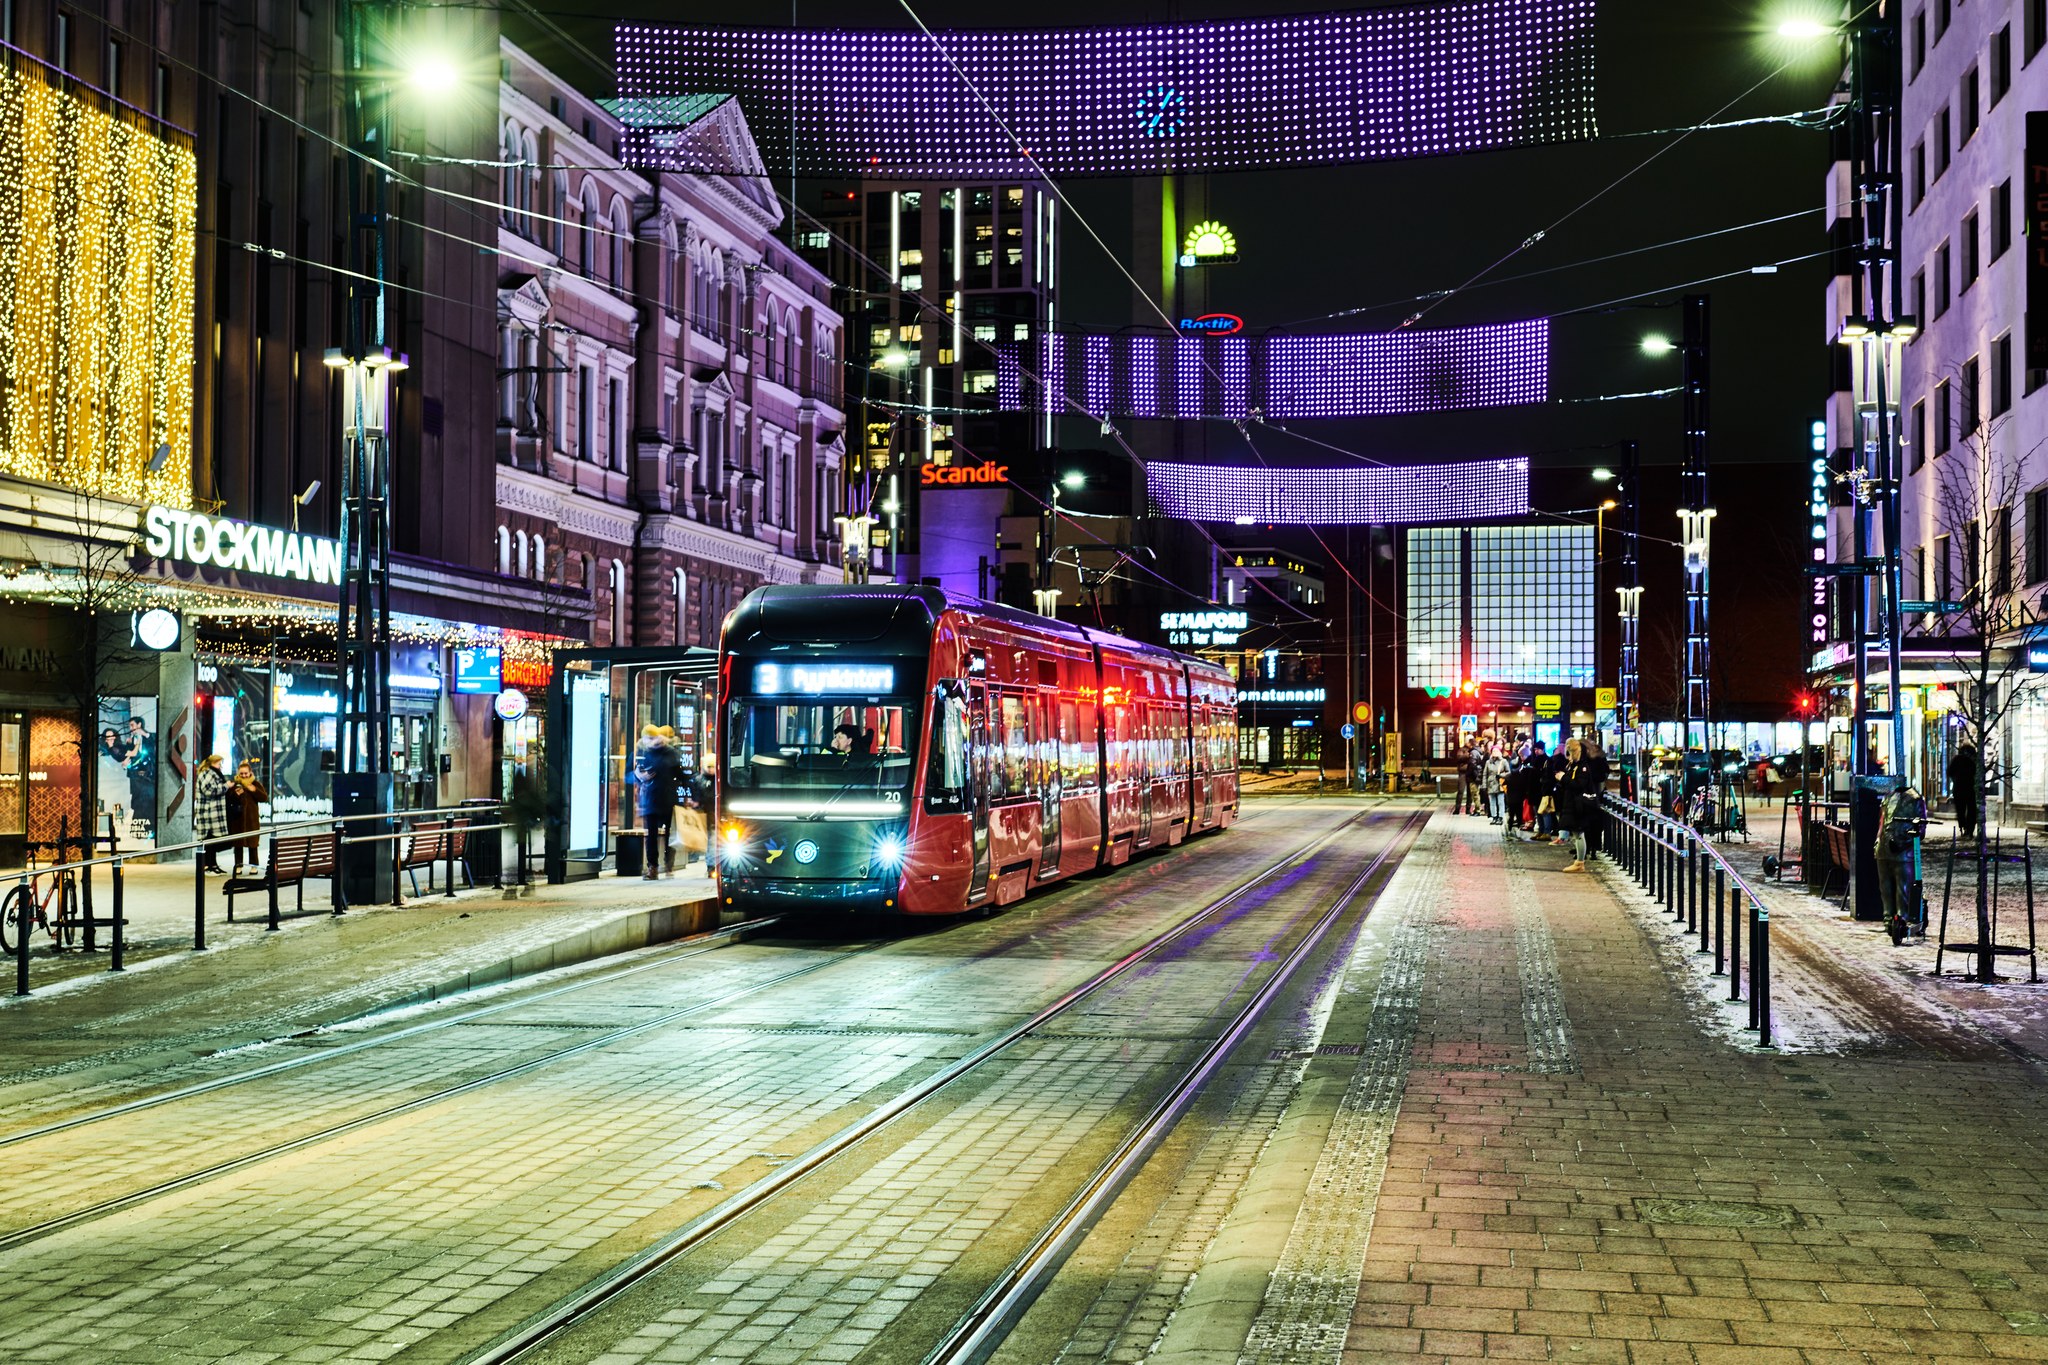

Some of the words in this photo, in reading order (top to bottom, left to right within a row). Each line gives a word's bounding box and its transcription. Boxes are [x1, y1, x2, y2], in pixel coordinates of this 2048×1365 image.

[921, 461, 1009, 484] Scandic
[1812, 458, 1827, 517] CALM
[146, 505, 341, 586] STOCKMANN
[1813, 548, 1826, 606] BZZ
[1160, 612, 1248, 630] SEMAFORI
[1813, 614, 1827, 642] ON
[197, 662, 217, 683] koo
[276, 668, 293, 687] koo
[760, 663, 778, 693] 3
[1602, 694, 1611, 702] 40
[885, 792, 901, 803] 20
